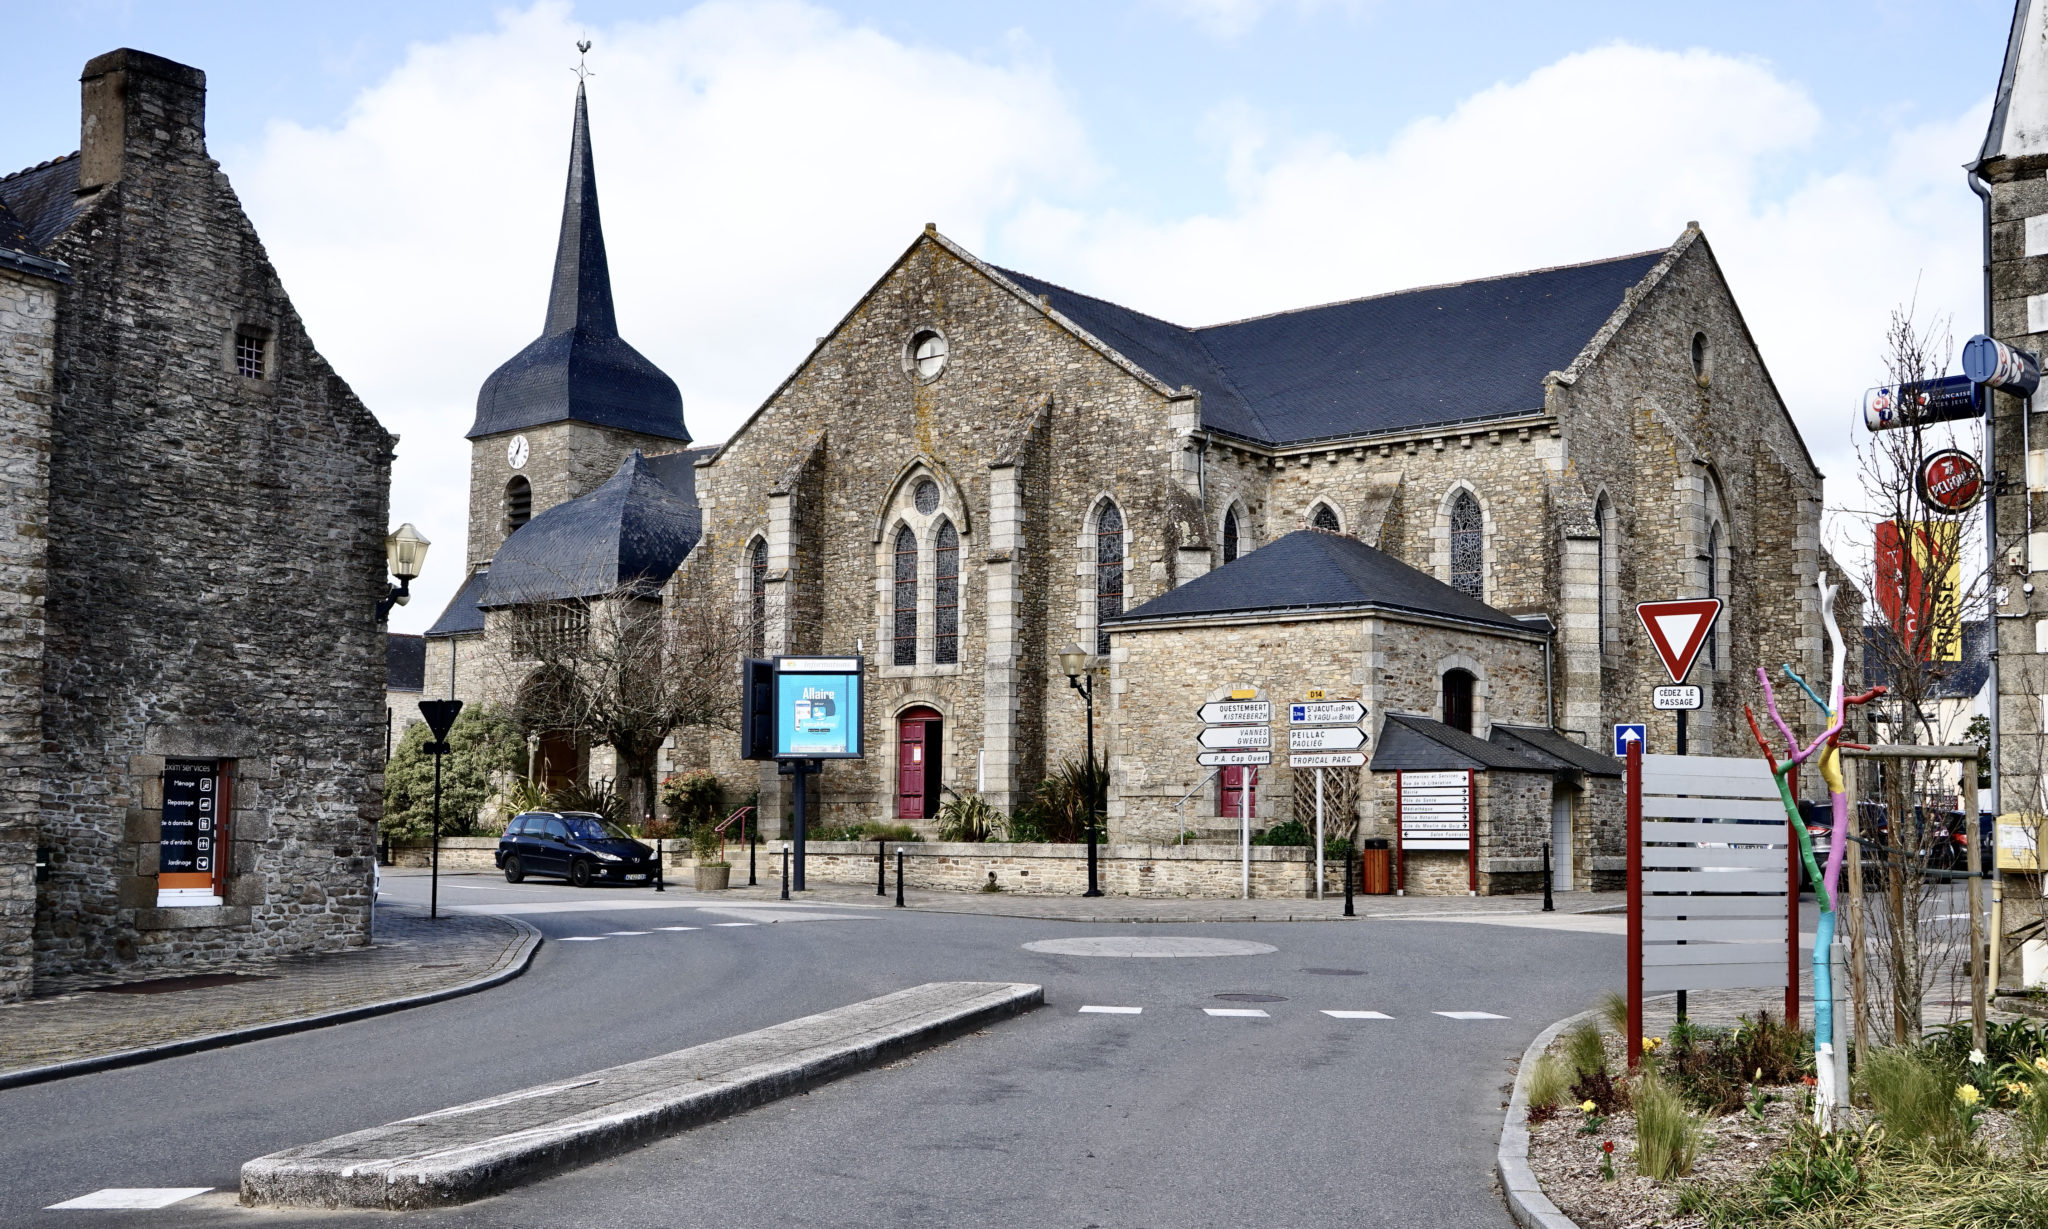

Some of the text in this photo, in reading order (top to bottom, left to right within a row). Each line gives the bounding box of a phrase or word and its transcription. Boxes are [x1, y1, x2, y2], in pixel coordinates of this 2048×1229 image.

[802, 687, 835, 700] Allaire
[1659, 687, 1694, 697] CÉDEZ LE
[1660, 698, 1693, 706] PASSAGE
[1219, 703, 1267, 712] QUESTEMBERT
[1223, 712, 1268, 720] KISTREBERZH
[1314, 713, 1331, 721] YAGU
[1240, 729, 1267, 737] VANNES
[1292, 731, 1325, 739] PEILLAC
[1237, 737, 1267, 745] GWENED
[1231, 755, 1245, 763] Cap
[1248, 754, 1268, 762] Ouest
[173, 780, 195, 788] Ménage
[167, 799, 194, 807] Repassage
[167, 859, 192, 867] Jardinage
